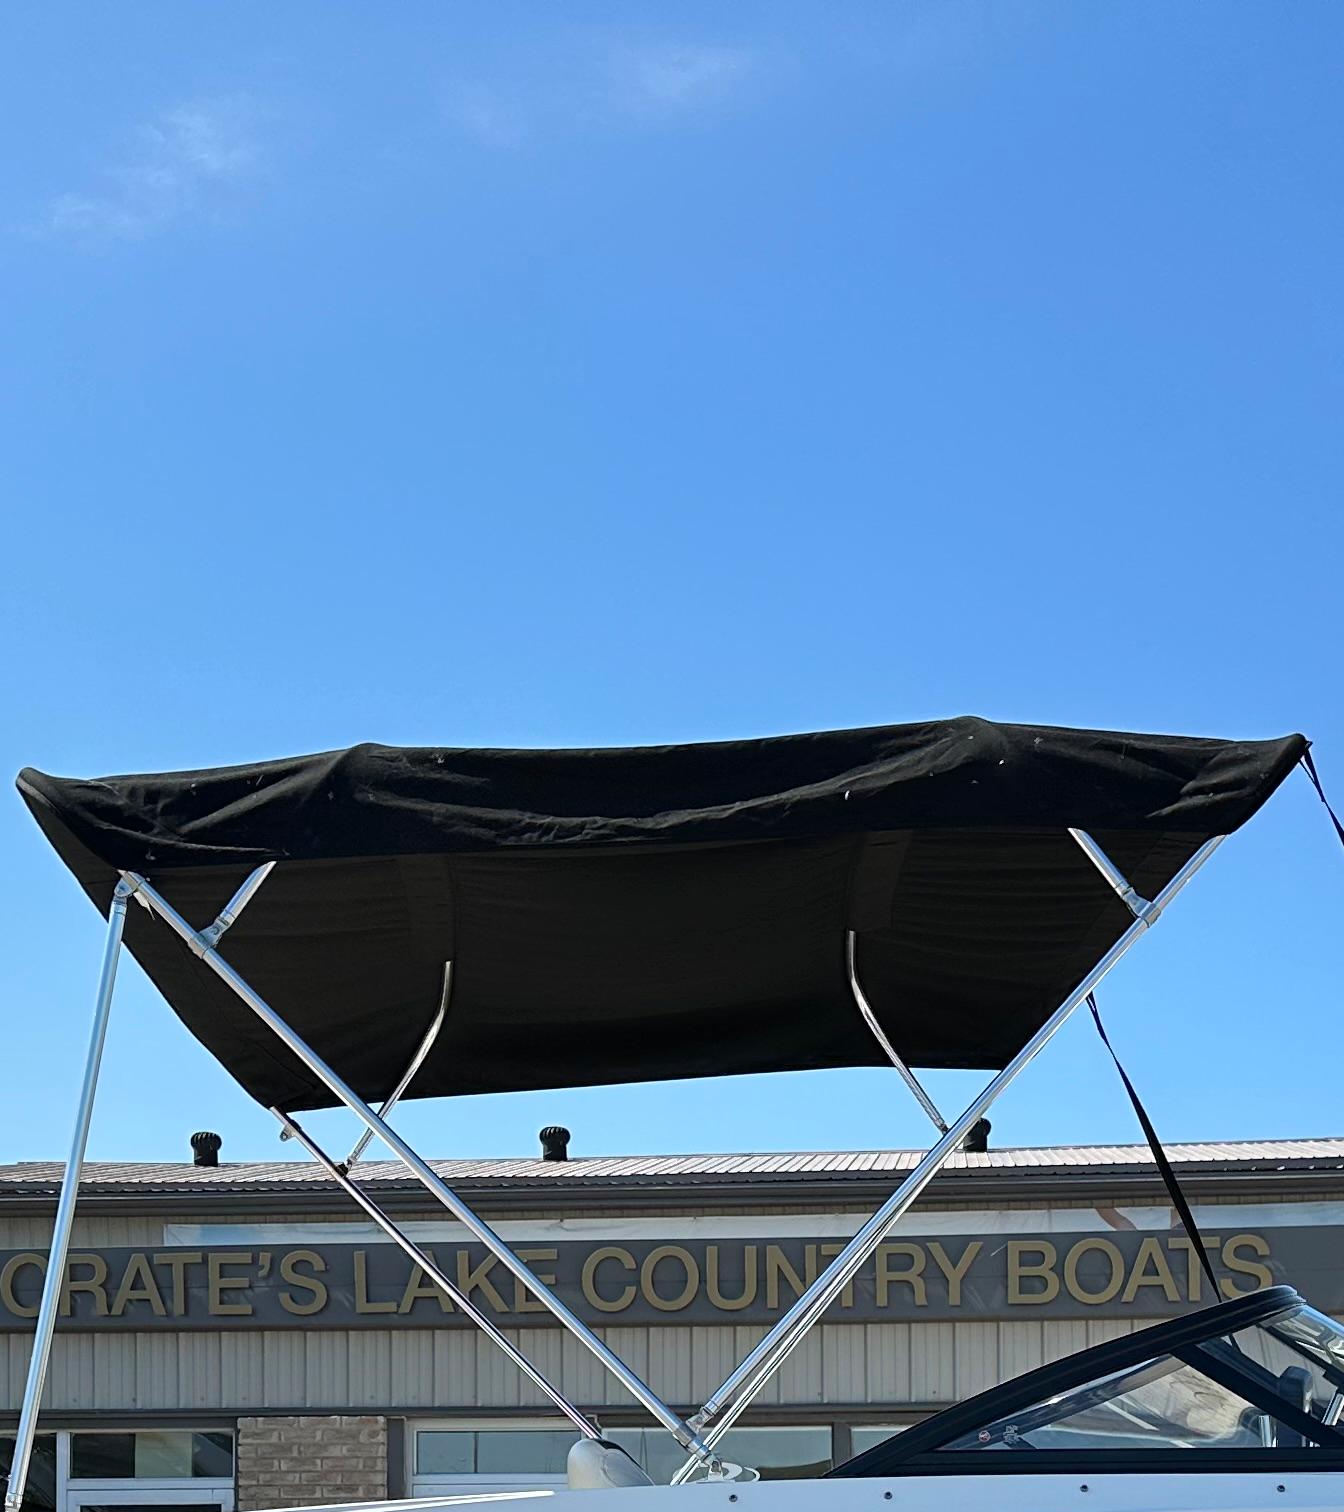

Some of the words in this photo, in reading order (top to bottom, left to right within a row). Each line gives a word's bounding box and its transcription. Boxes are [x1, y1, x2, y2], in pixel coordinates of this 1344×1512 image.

[0, 1250, 328, 1318] CRATE'S
[355, 1248, 558, 1314] LAKE
[1007, 1233, 1273, 1306] BOATS
